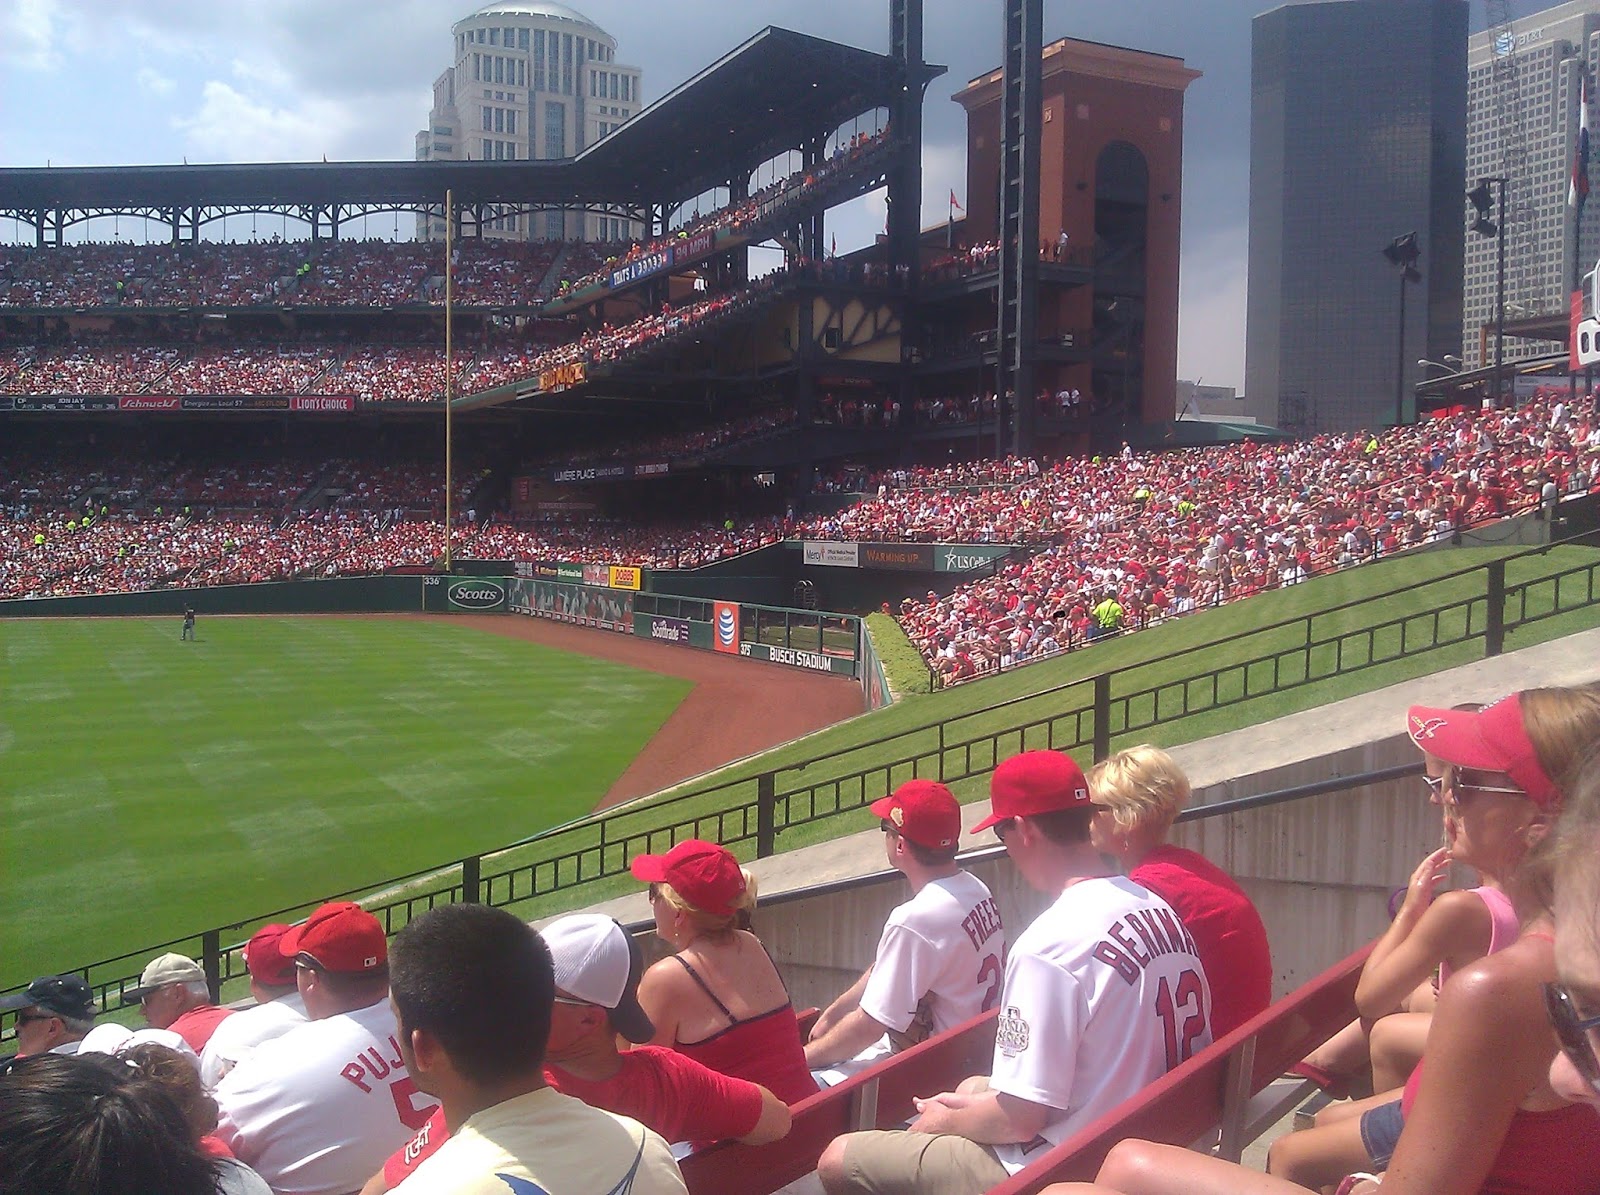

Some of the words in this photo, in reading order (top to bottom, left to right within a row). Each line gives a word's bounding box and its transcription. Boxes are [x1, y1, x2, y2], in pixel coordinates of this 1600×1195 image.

[690, 235, 710, 255] MPH
[122, 399, 178, 408] Schnucks
[296, 397, 320, 410] LION'S
[320, 398, 348, 410] CHOICE
[576, 468, 596, 480] PLACE
[866, 549, 905, 562] WARMING
[615, 568, 635, 581] DOBBS
[455, 587, 497, 600] Scotts
[651, 620, 680, 641] Scottrade
[769, 647, 795, 665] BUSCH
[796, 651, 832, 672] STADIUM
[1156, 968, 1206, 1074] 12
